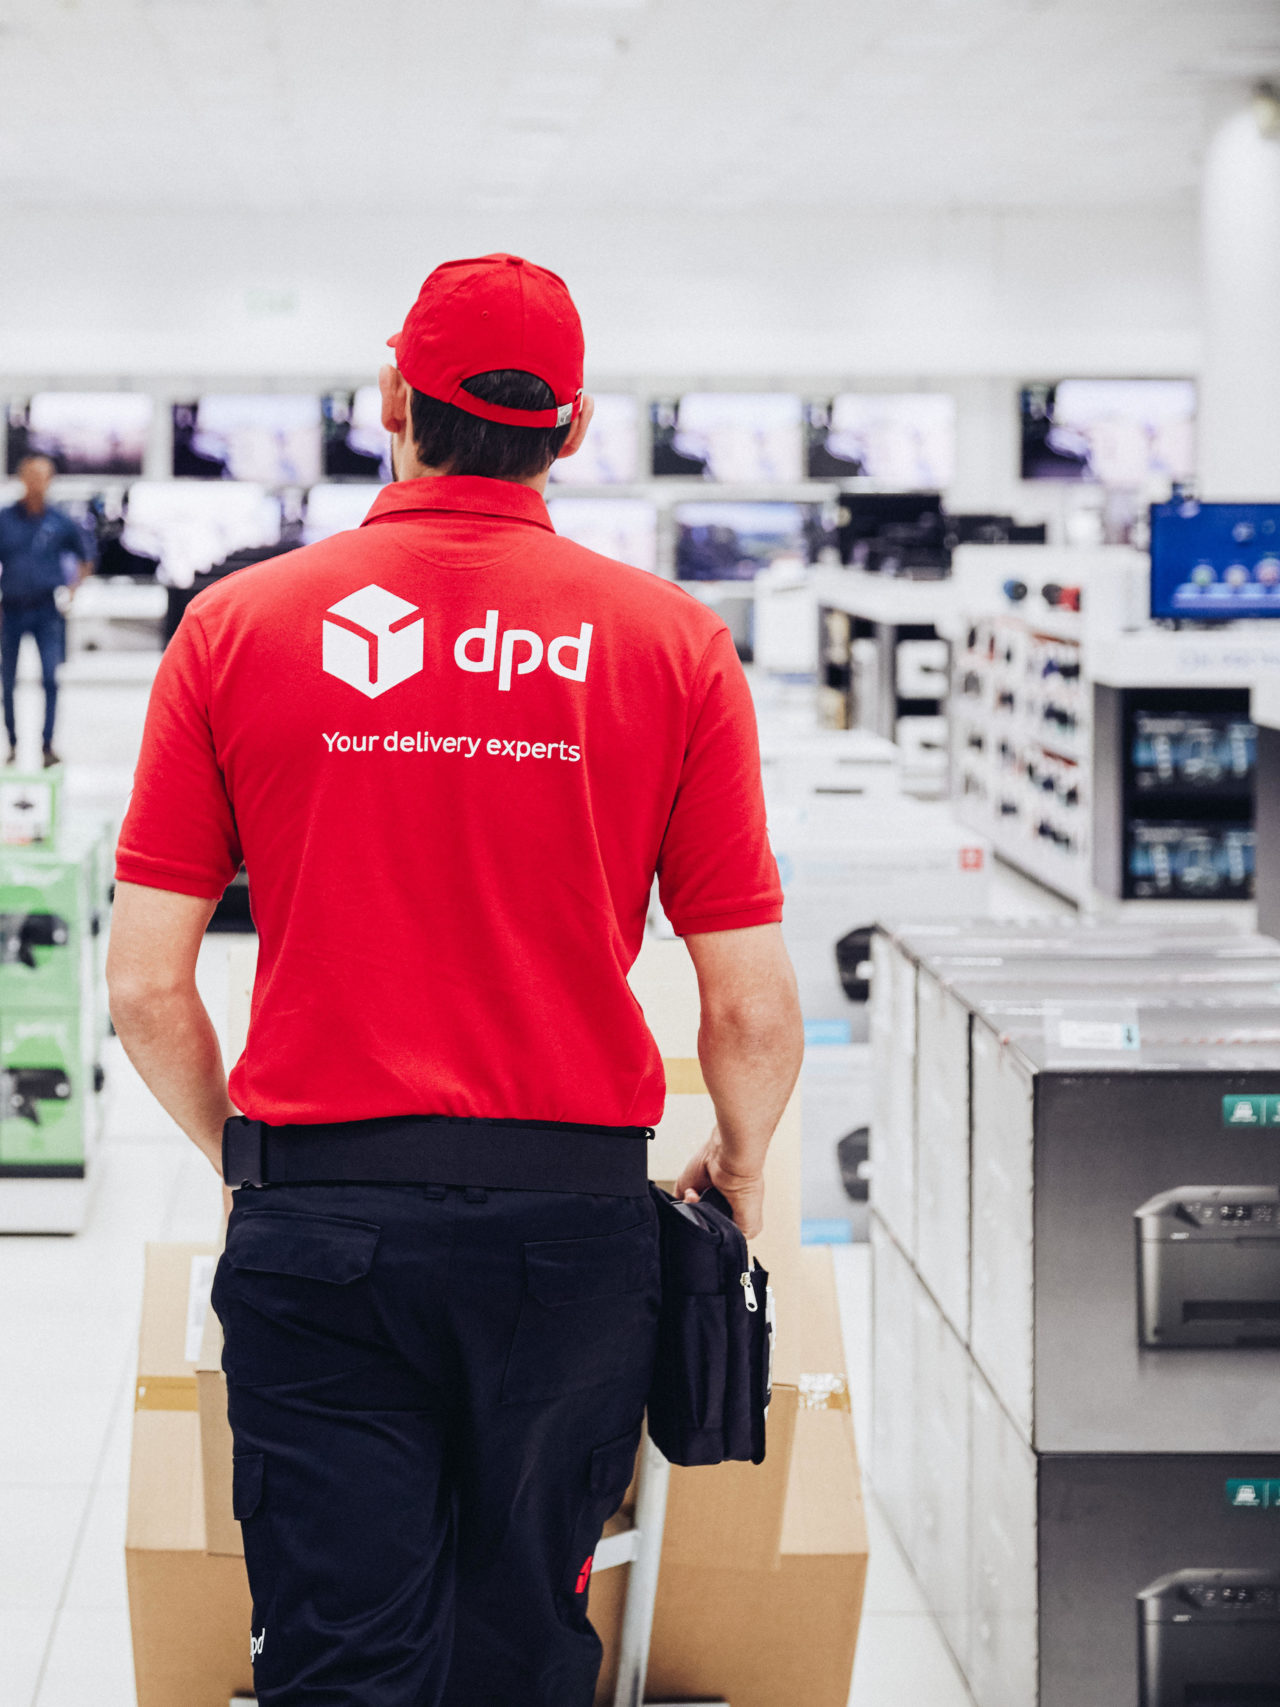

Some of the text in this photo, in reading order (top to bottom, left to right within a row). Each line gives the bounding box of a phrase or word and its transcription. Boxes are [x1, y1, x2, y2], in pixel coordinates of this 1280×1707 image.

[454, 610, 593, 691] dpd
[322, 731, 581, 762] Your delivery experts
[249, 1627, 266, 1663] pd
